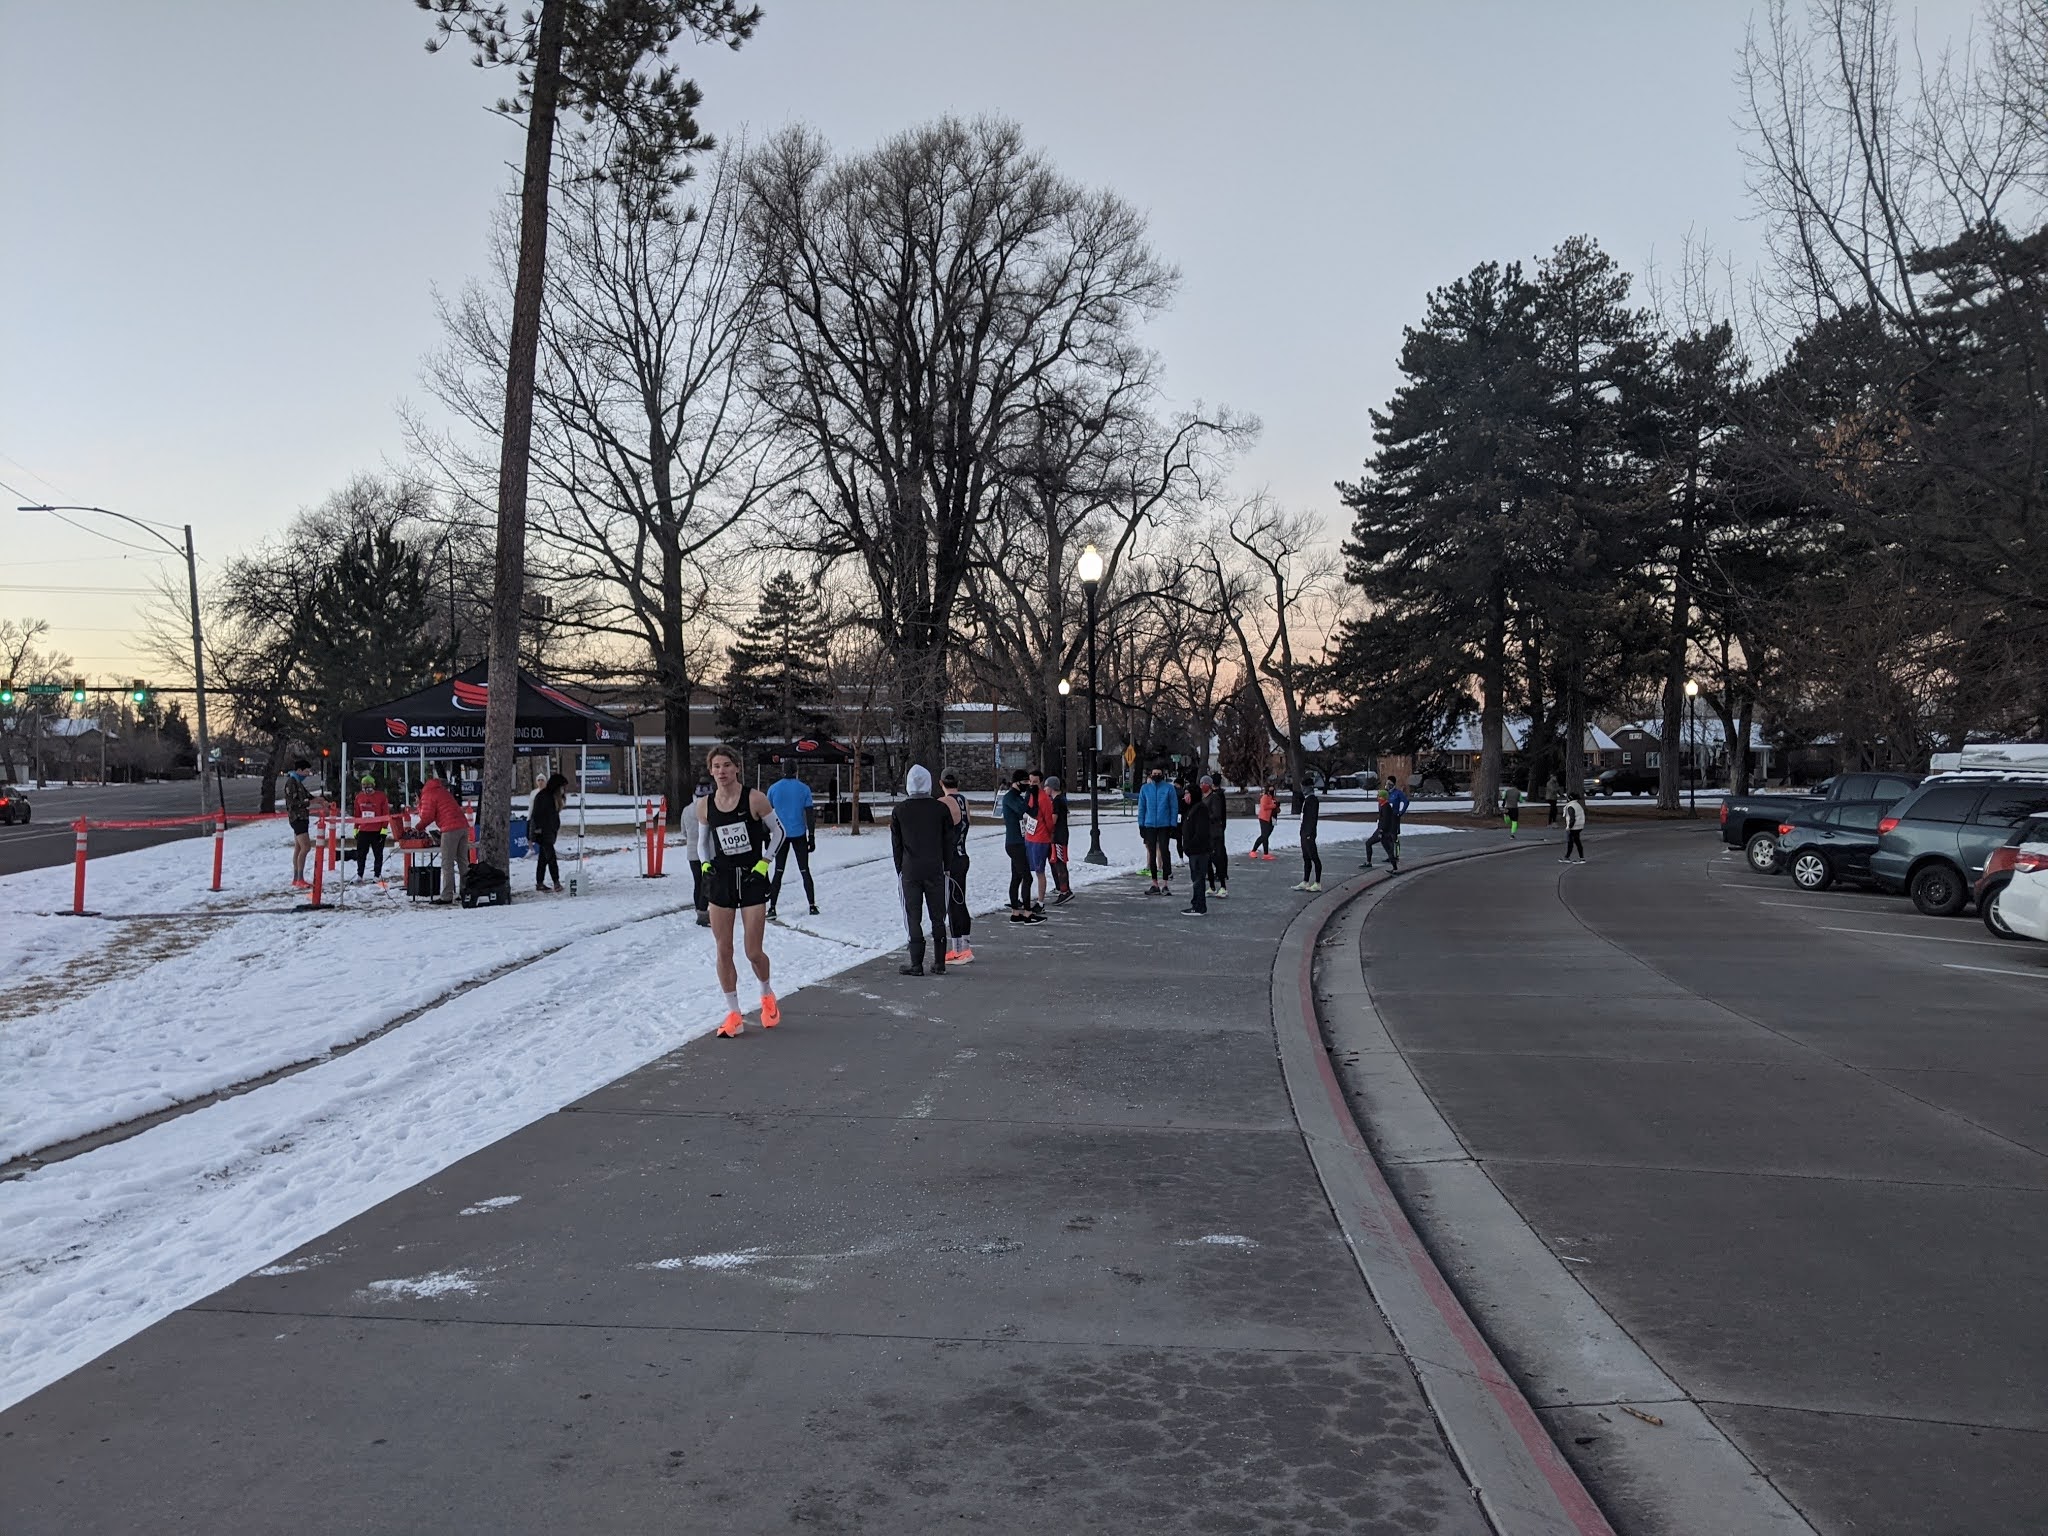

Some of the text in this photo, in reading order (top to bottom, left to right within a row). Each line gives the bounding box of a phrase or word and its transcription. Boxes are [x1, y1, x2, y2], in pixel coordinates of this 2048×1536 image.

[410, 726, 446, 738] SLRC
[450, 726, 470, 738] SALT
[471, 726, 487, 738] LAK
[386, 746, 410, 755] SLRC
[722, 834, 747, 846] 1090
